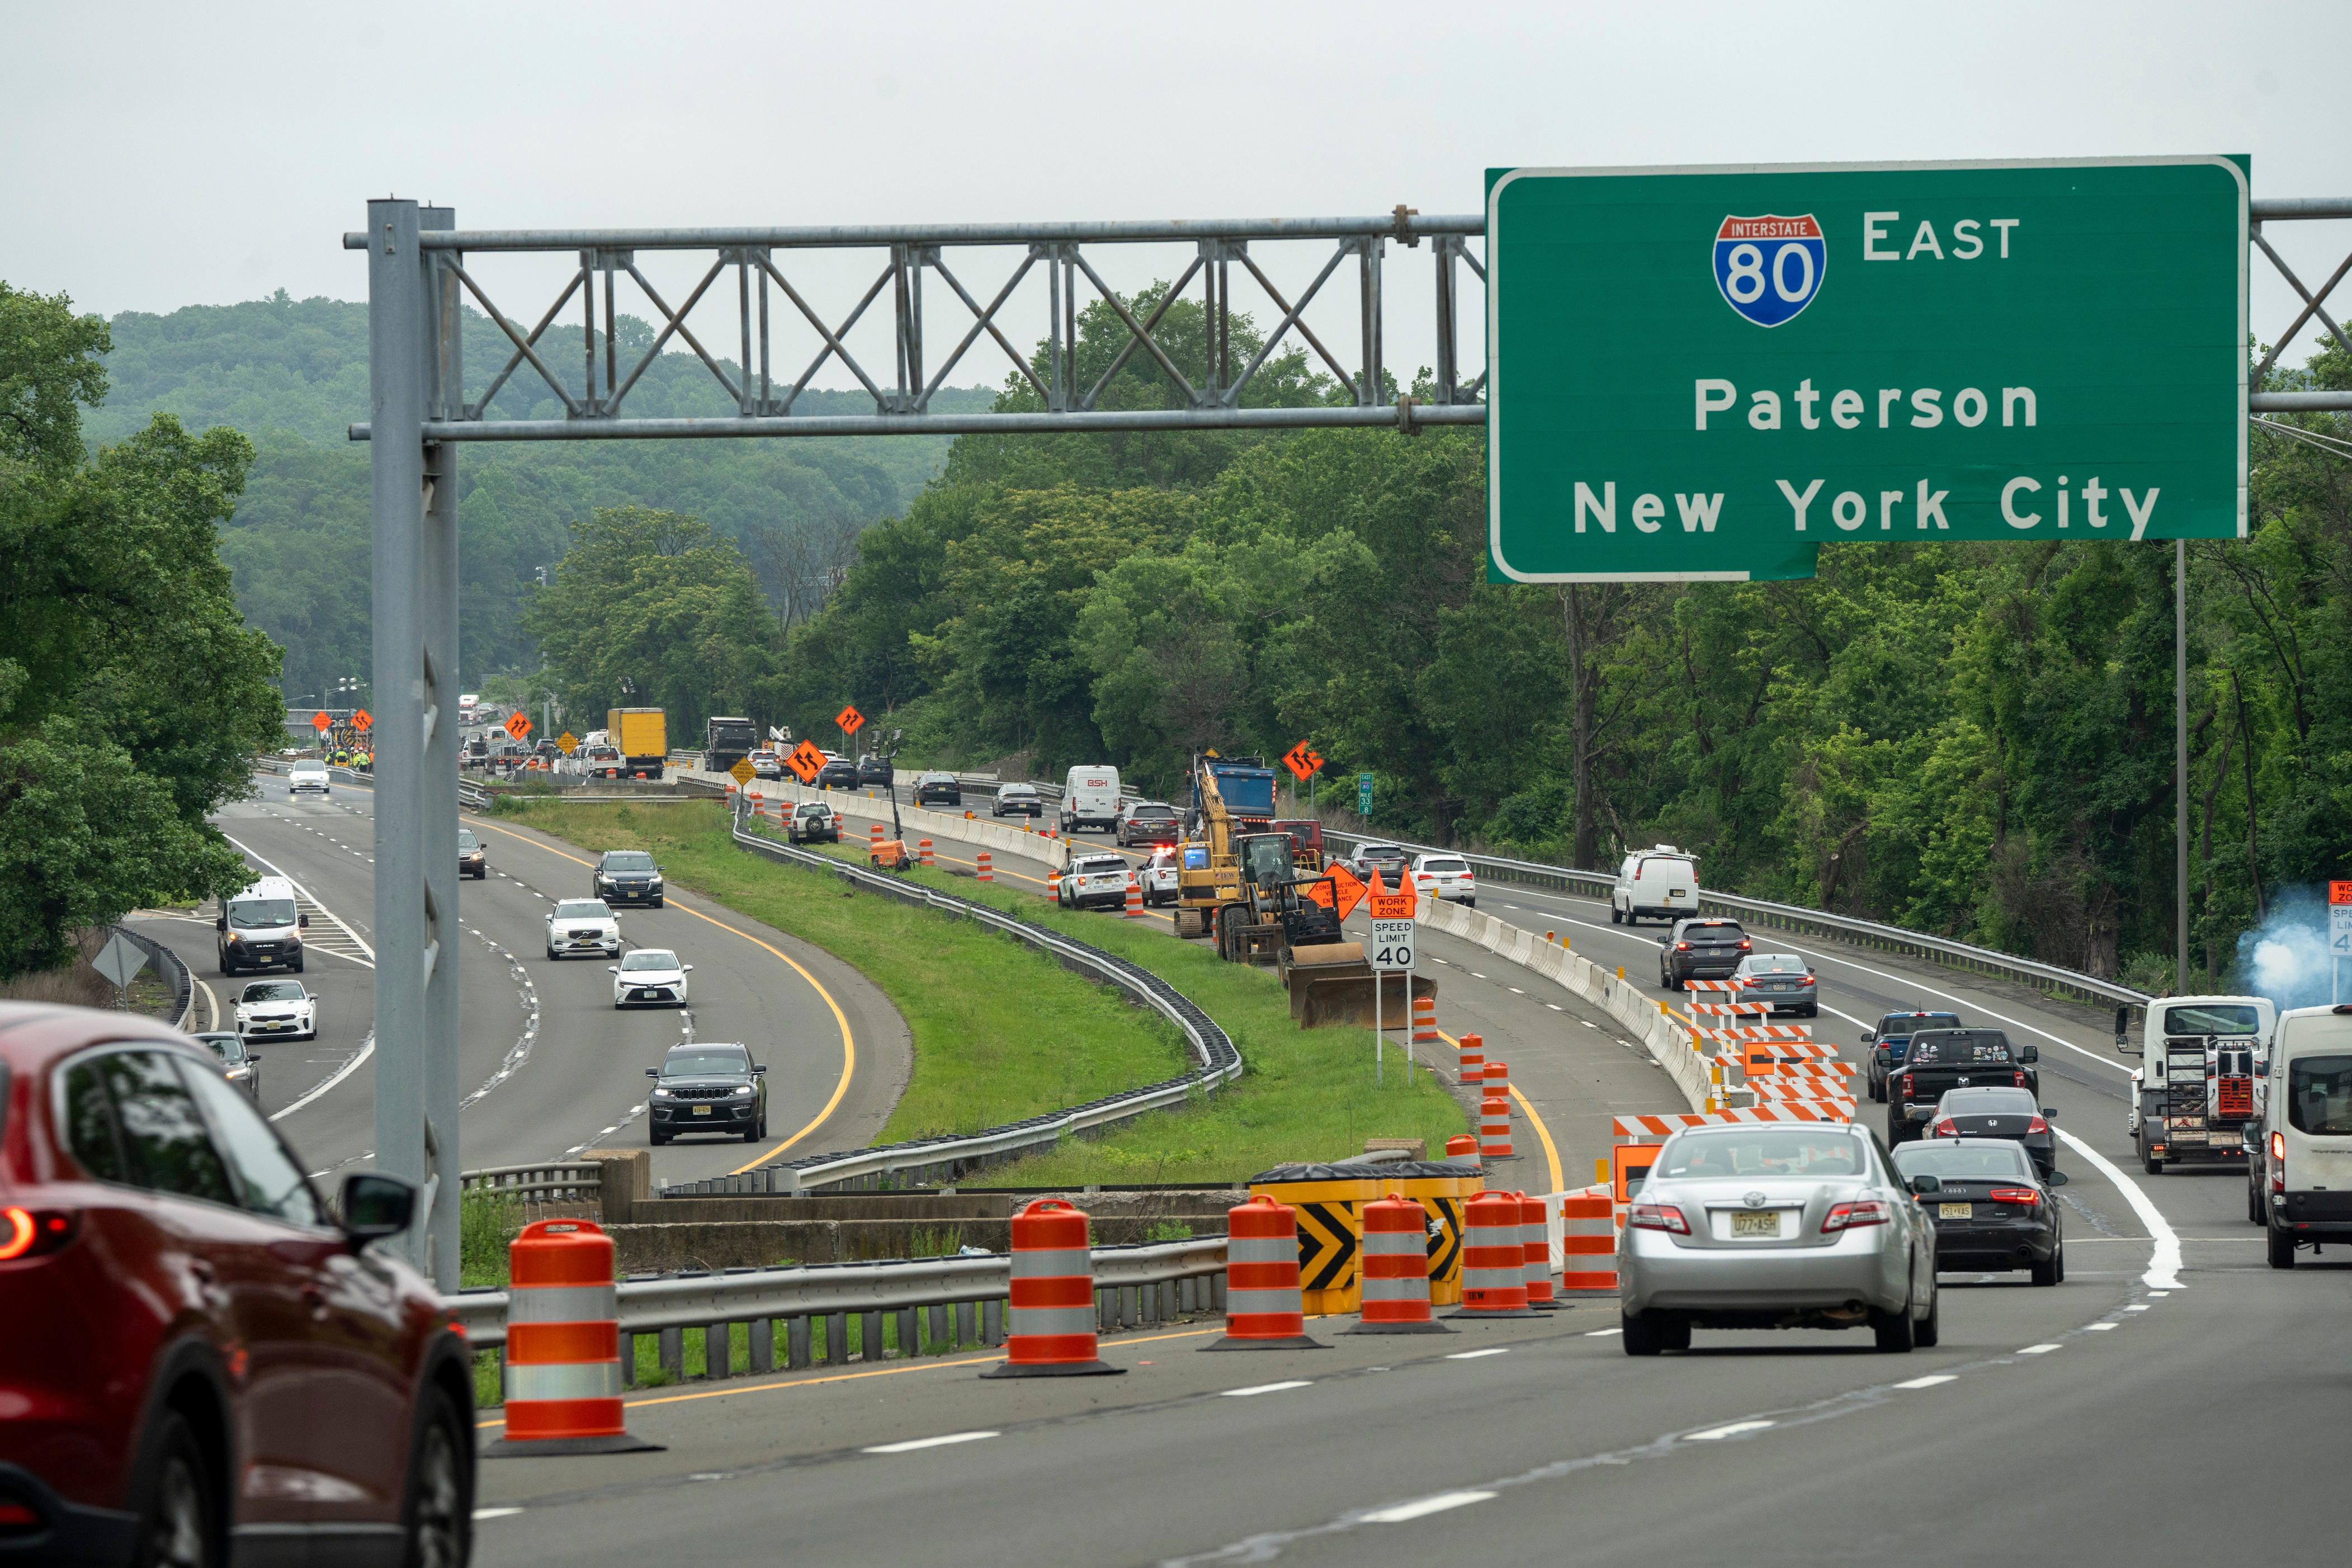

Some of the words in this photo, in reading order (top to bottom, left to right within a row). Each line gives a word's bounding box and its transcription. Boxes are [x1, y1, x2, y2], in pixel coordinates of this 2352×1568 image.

[1731, 222, 1808, 237] INTERSTATE
[1864, 211, 2019, 261] EAST
[1726, 243, 1814, 304] 80
[1695, 379, 2036, 431] Paterson
[1574, 481, 1724, 533] New
[1775, 479, 1949, 531] York
[2001, 475, 2160, 541] City
[1315, 881, 1357, 891] CONSUCTION
[1323, 895, 1352, 904] ENTANCE
[2334, 909, 2352, 918] SPE
[1375, 923, 1411, 932] SPEED
[2334, 934, 2351, 952] 4
[1376, 947, 1411, 965] 40
[1467, 1291, 1486, 1300] IEW
